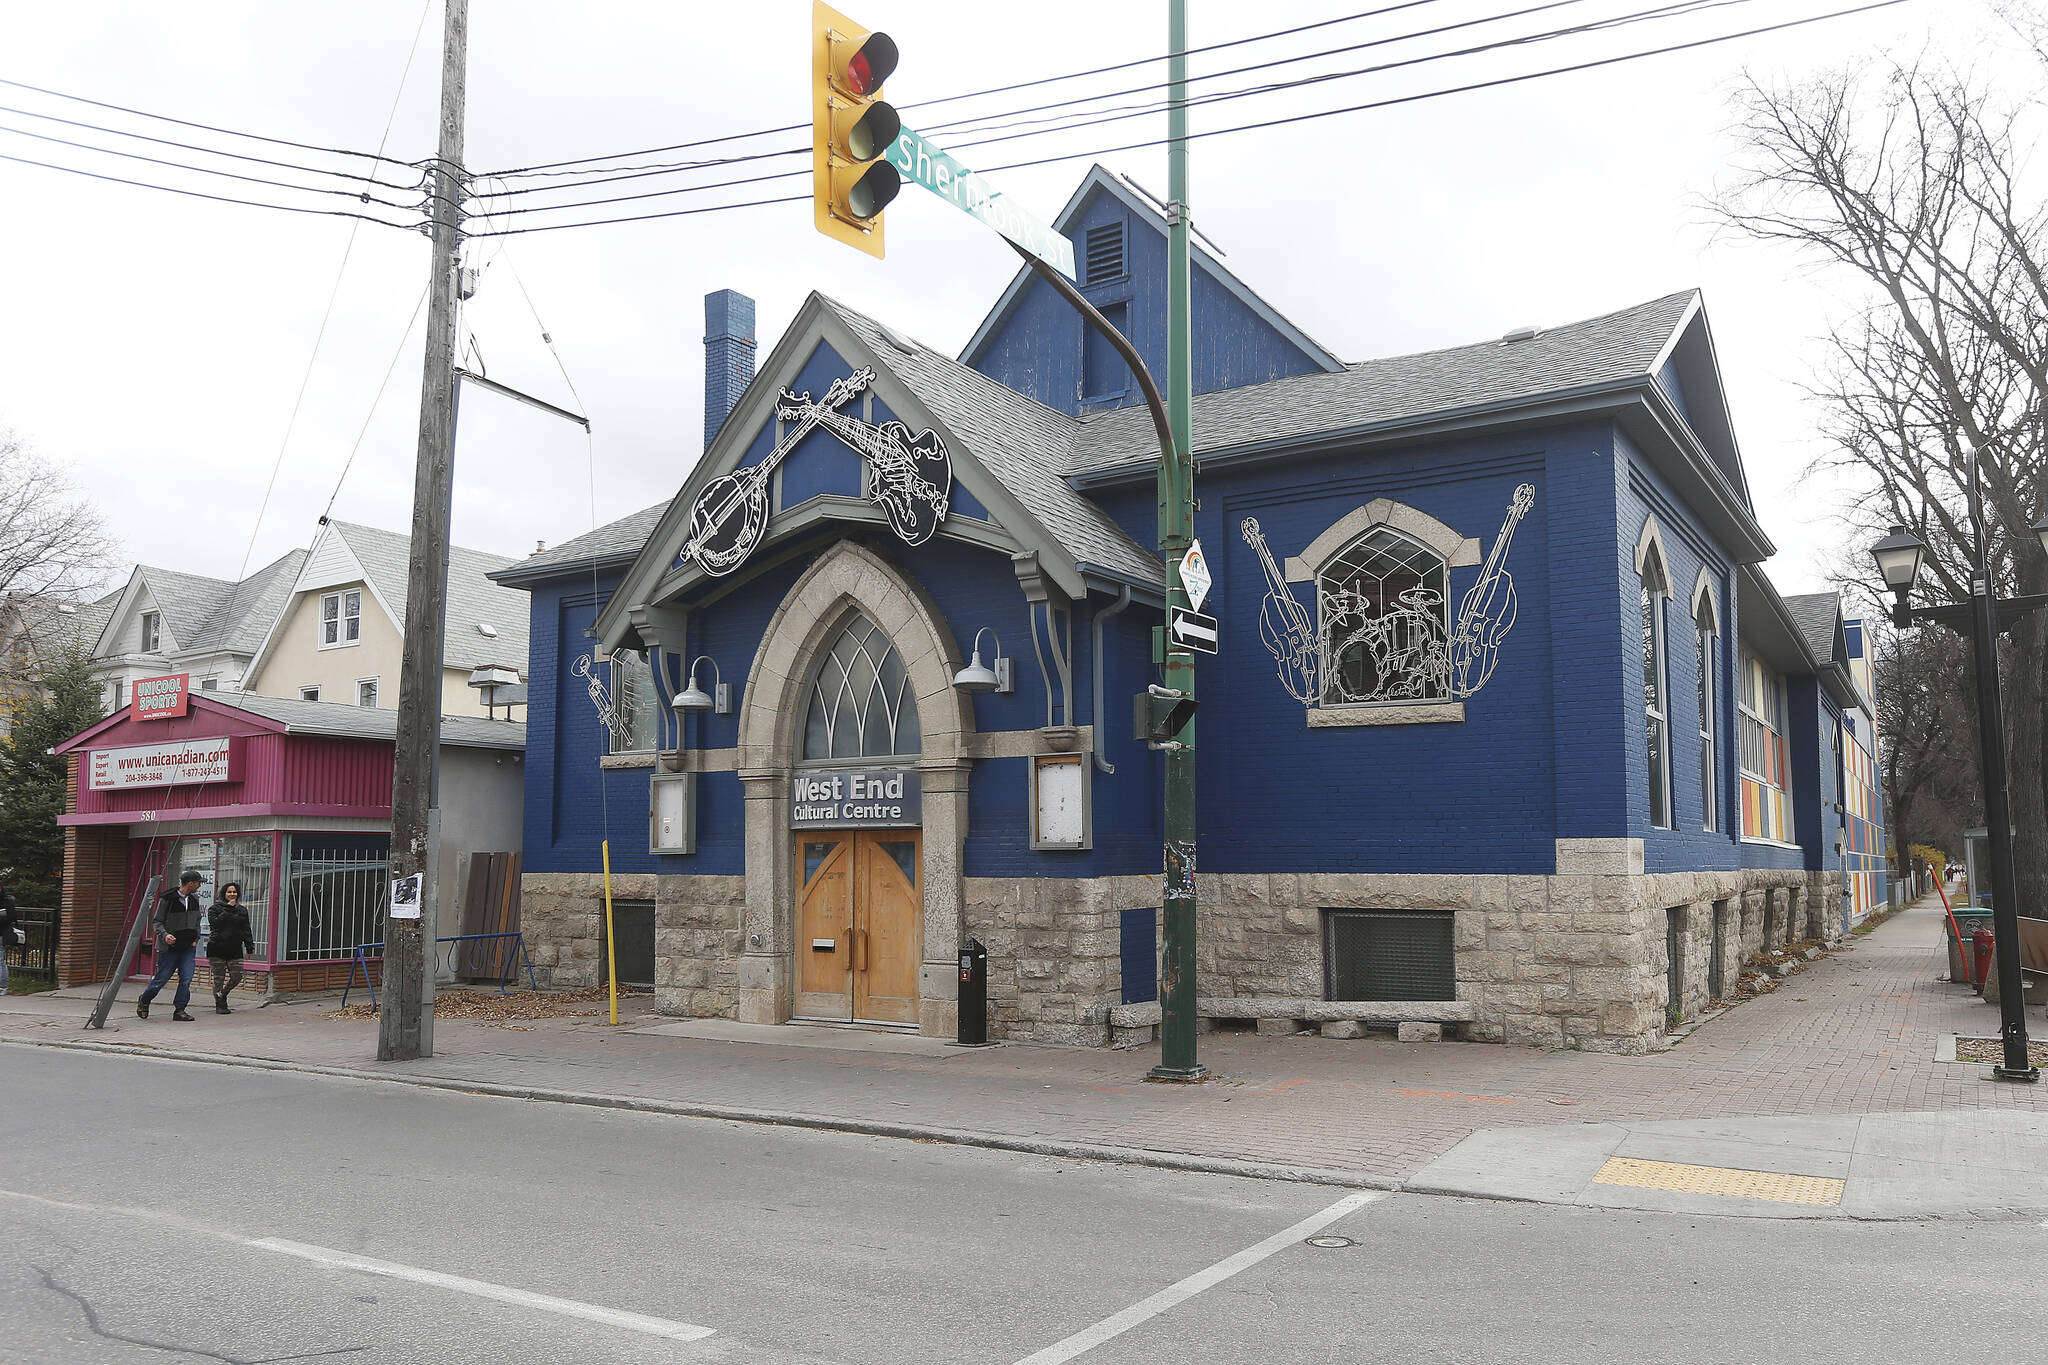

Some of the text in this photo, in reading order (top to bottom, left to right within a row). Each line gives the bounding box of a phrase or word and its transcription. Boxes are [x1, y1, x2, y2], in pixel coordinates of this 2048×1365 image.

[897, 134, 1067, 271] Sherbrook St
[137, 677, 182, 697] UNICOOL
[139, 693, 178, 711] SPORTS
[118, 749, 229, 770] www.unicanadian.com
[125, 772, 163, 783] 204-396-3848
[182, 766, 227, 777] 1-877-243-4511
[794, 773, 904, 802] West End
[140, 810, 156, 821] 580
[793, 803, 902, 821] Cultural Centre
